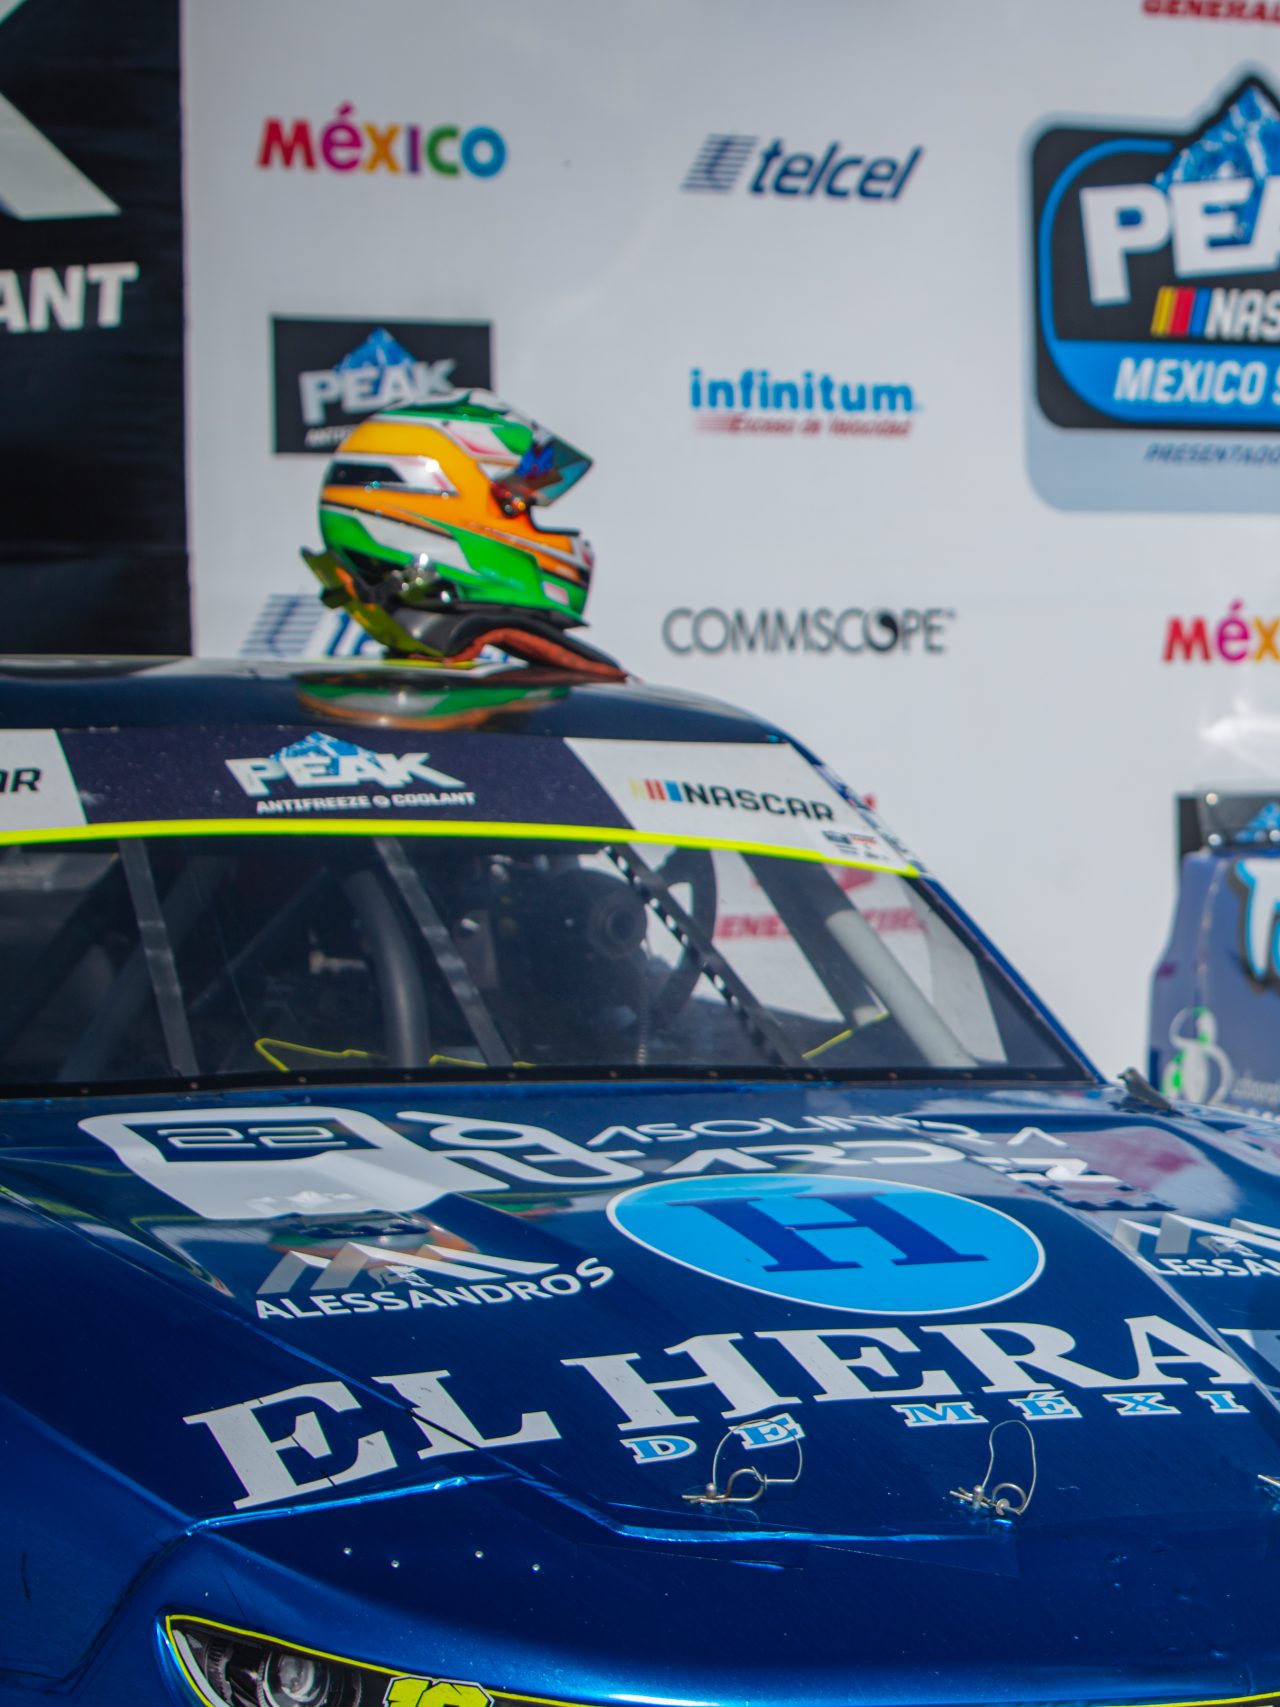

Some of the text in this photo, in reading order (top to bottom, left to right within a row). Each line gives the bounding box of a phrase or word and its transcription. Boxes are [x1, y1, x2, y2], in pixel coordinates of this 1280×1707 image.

[258, 100, 508, 178] México
[749, 138, 925, 203] telcel
[691, 367, 913, 412] infinitum
[1113, 357, 1269, 406] MEXICO
[662, 608, 946, 655] COMMSCOPE
[225, 752, 467, 797] PEAK
[257, 791, 476, 815] ANTIFREEZE COOLANT
[681, 781, 835, 822] NASCAR
[157, 1126, 348, 1150] 22
[666, 1191, 990, 1273] H
[255, 1257, 617, 1319] ALESSANDROS
[182, 1370, 562, 1510] EL
[620, 1413, 806, 1464] DE
